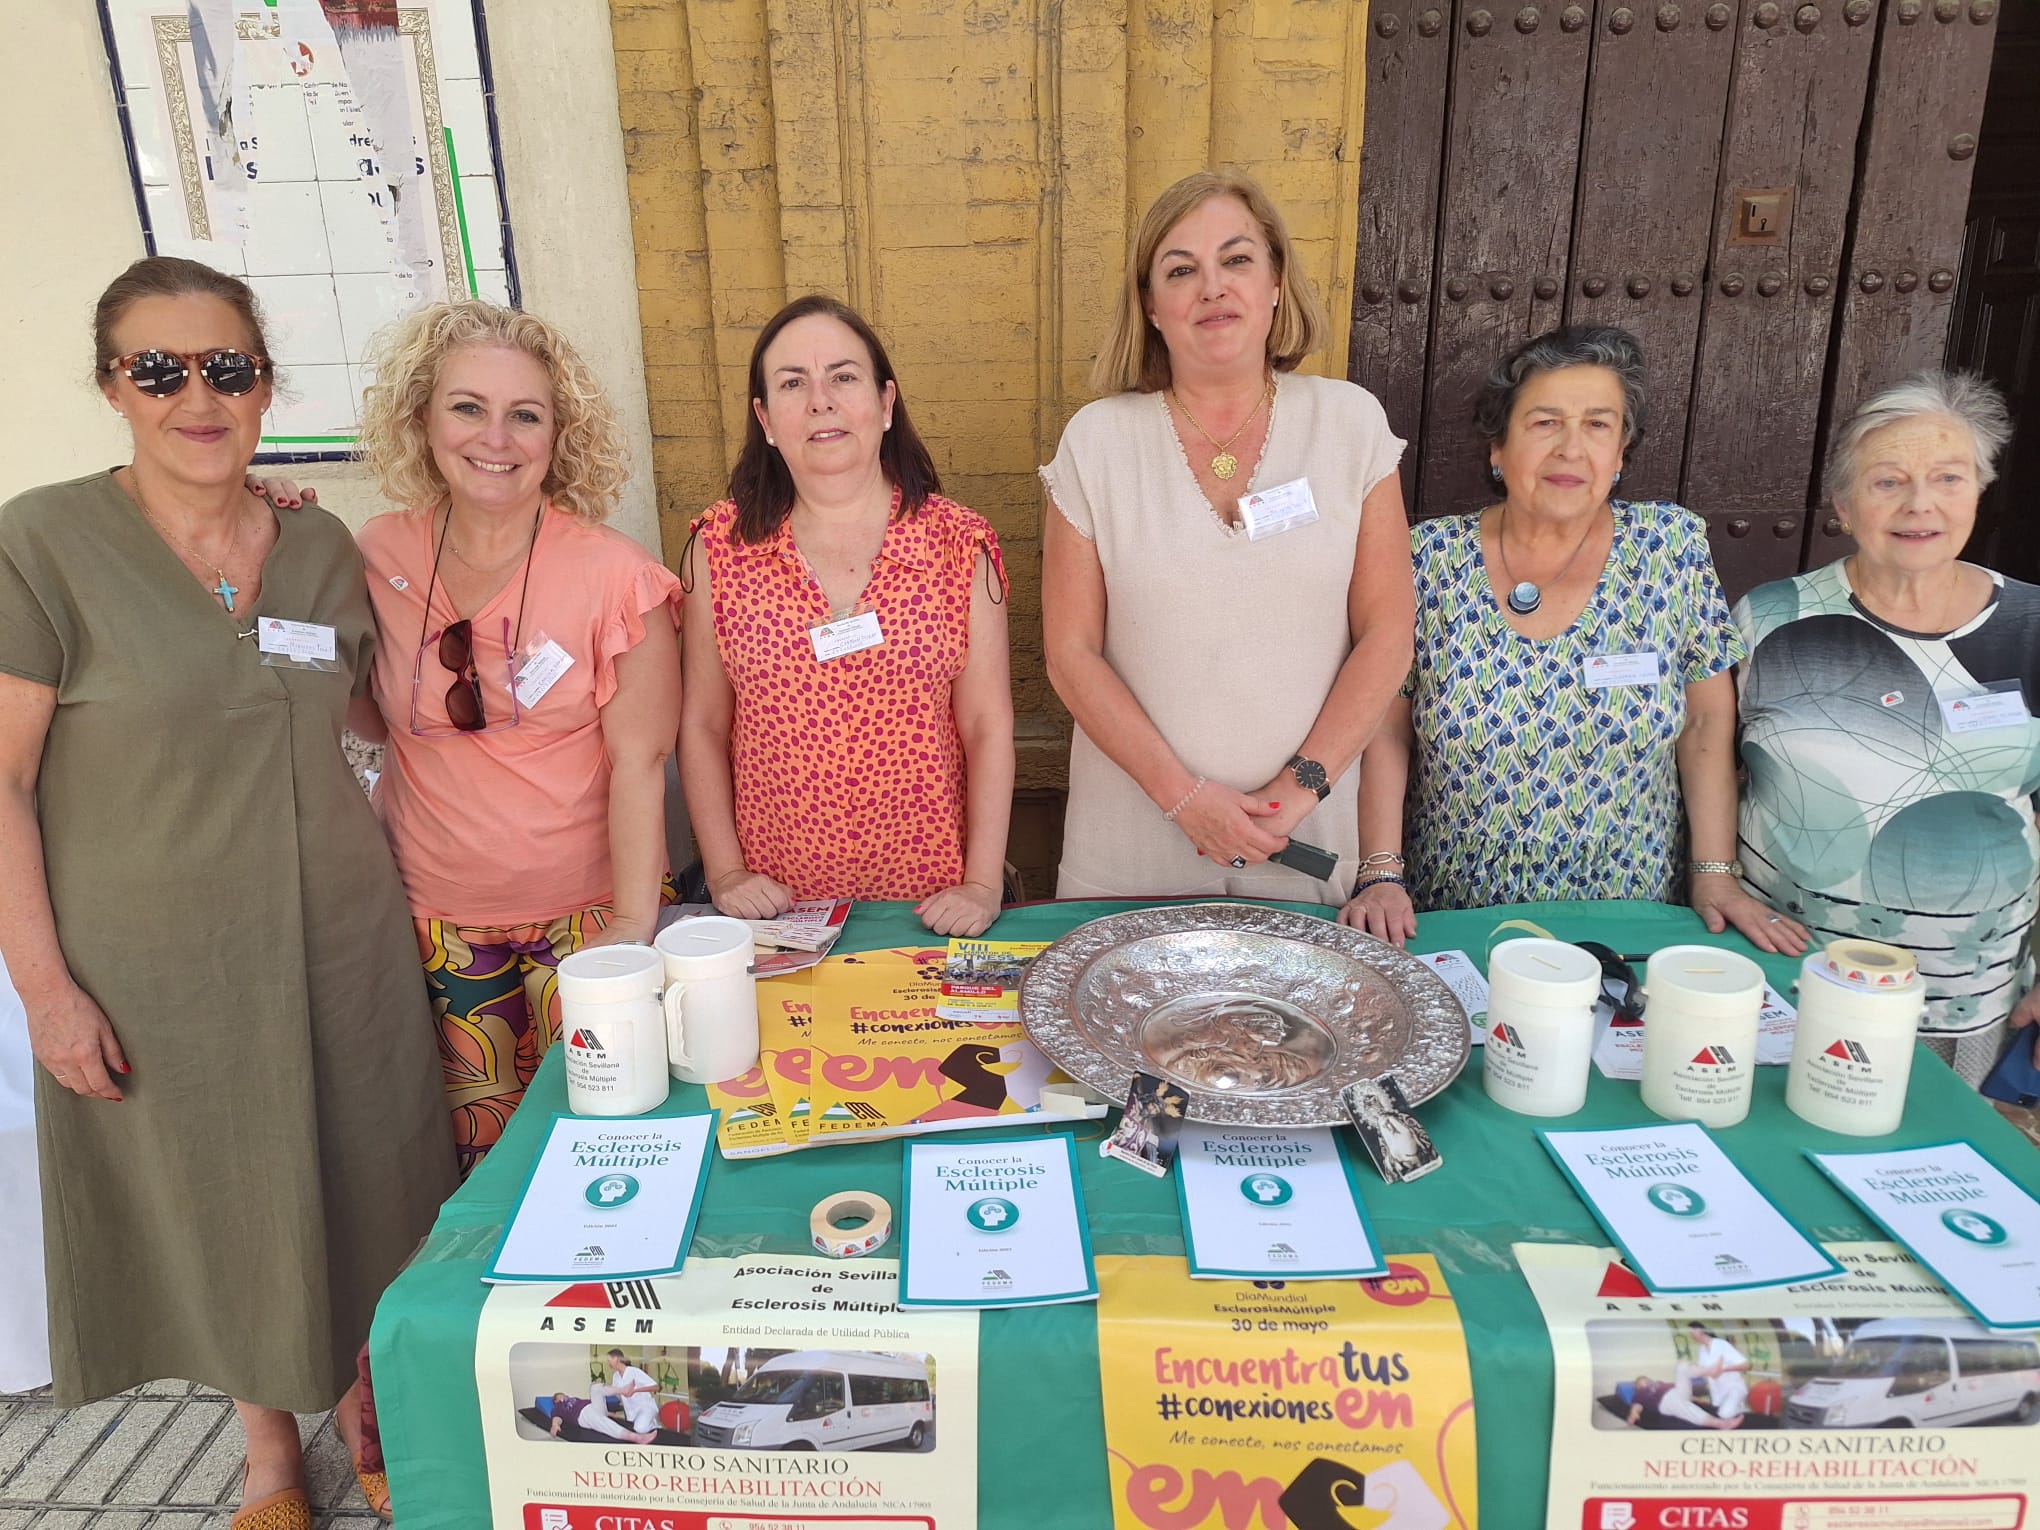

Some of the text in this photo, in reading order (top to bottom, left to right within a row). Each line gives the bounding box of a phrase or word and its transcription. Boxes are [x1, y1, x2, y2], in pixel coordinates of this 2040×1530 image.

[958, 942, 989, 952] VIII
[954, 953, 1015, 961] FITNESS
[858, 1038, 877, 1046] Me
[569, 1047, 606, 1060] ASEM
[1687, 1065, 1737, 1074] ASEM
[1819, 1055, 1872, 1073] ASEM
[819, 1120, 889, 1131] FEDEMA
[598, 1132, 662, 1140] Conocer la
[1222, 1133, 1287, 1141] Conocer la
[570, 1139, 682, 1153] Esclerosis
[1202, 1140, 1312, 1153] Esclerosis
[1600, 1144, 1651, 1152] Conocer
[573, 1154, 669, 1168] Múltiple
[957, 1155, 1022, 1165] Conocer la
[1214, 1155, 1306, 1169] Múltiple
[1585, 1147, 1698, 1166] Esclerosis
[936, 1163, 1046, 1178] Esclerosis
[1604, 1162, 1701, 1179] Múltiple
[1875, 1167, 1926, 1176] Conocer
[945, 1177, 1038, 1192] Múltiple
[1864, 1170, 1980, 1191] Esclerosis
[1888, 1186, 1988, 1204] Múltiple
[733, 1266, 832, 1279] Asociación
[1854, 1268, 1877, 1278] de
[811, 1284, 834, 1294] de
[731, 1298, 827, 1311] Esclerosis
[1606, 1302, 1723, 1312] ASEM
[540, 1316, 654, 1333] ASEM
[1232, 1318, 1328, 1334] 30 de mayo
[722, 1325, 910, 1339] Entidad Declarada de Utilidad Pública
[1169, 1430, 1196, 1446] Me
[1272, 1440, 1301, 1450] nos
[1681, 1435, 1946, 1456] CENTRO SANITARIO
[604, 1450, 850, 1475] CENTRO SANITARIO
[1644, 1456, 1978, 1479] NEURO-REHABILITACIÓN
[573, 1470, 883, 1498] NEURO-REHABILITACIÓN
[526, 1488, 598, 1499] Funcionamiento
[600, 1491, 647, 1502] autorizado
[650, 1495, 663, 1505] por
[666, 1495, 675, 1503] la
[727, 1498, 738, 1506] de
[740, 1499, 766, 1508] Salud
[768, 1500, 779, 1508] de
[782, 1500, 790, 1508] la
[792, 1500, 816, 1509] Junta
[818, 1500, 829, 1509] de
[882, 1501, 906, 1509] NICA
[595, 1516, 674, 1530] CITAS
[1659, 1507, 1748, 1528] CITAS
